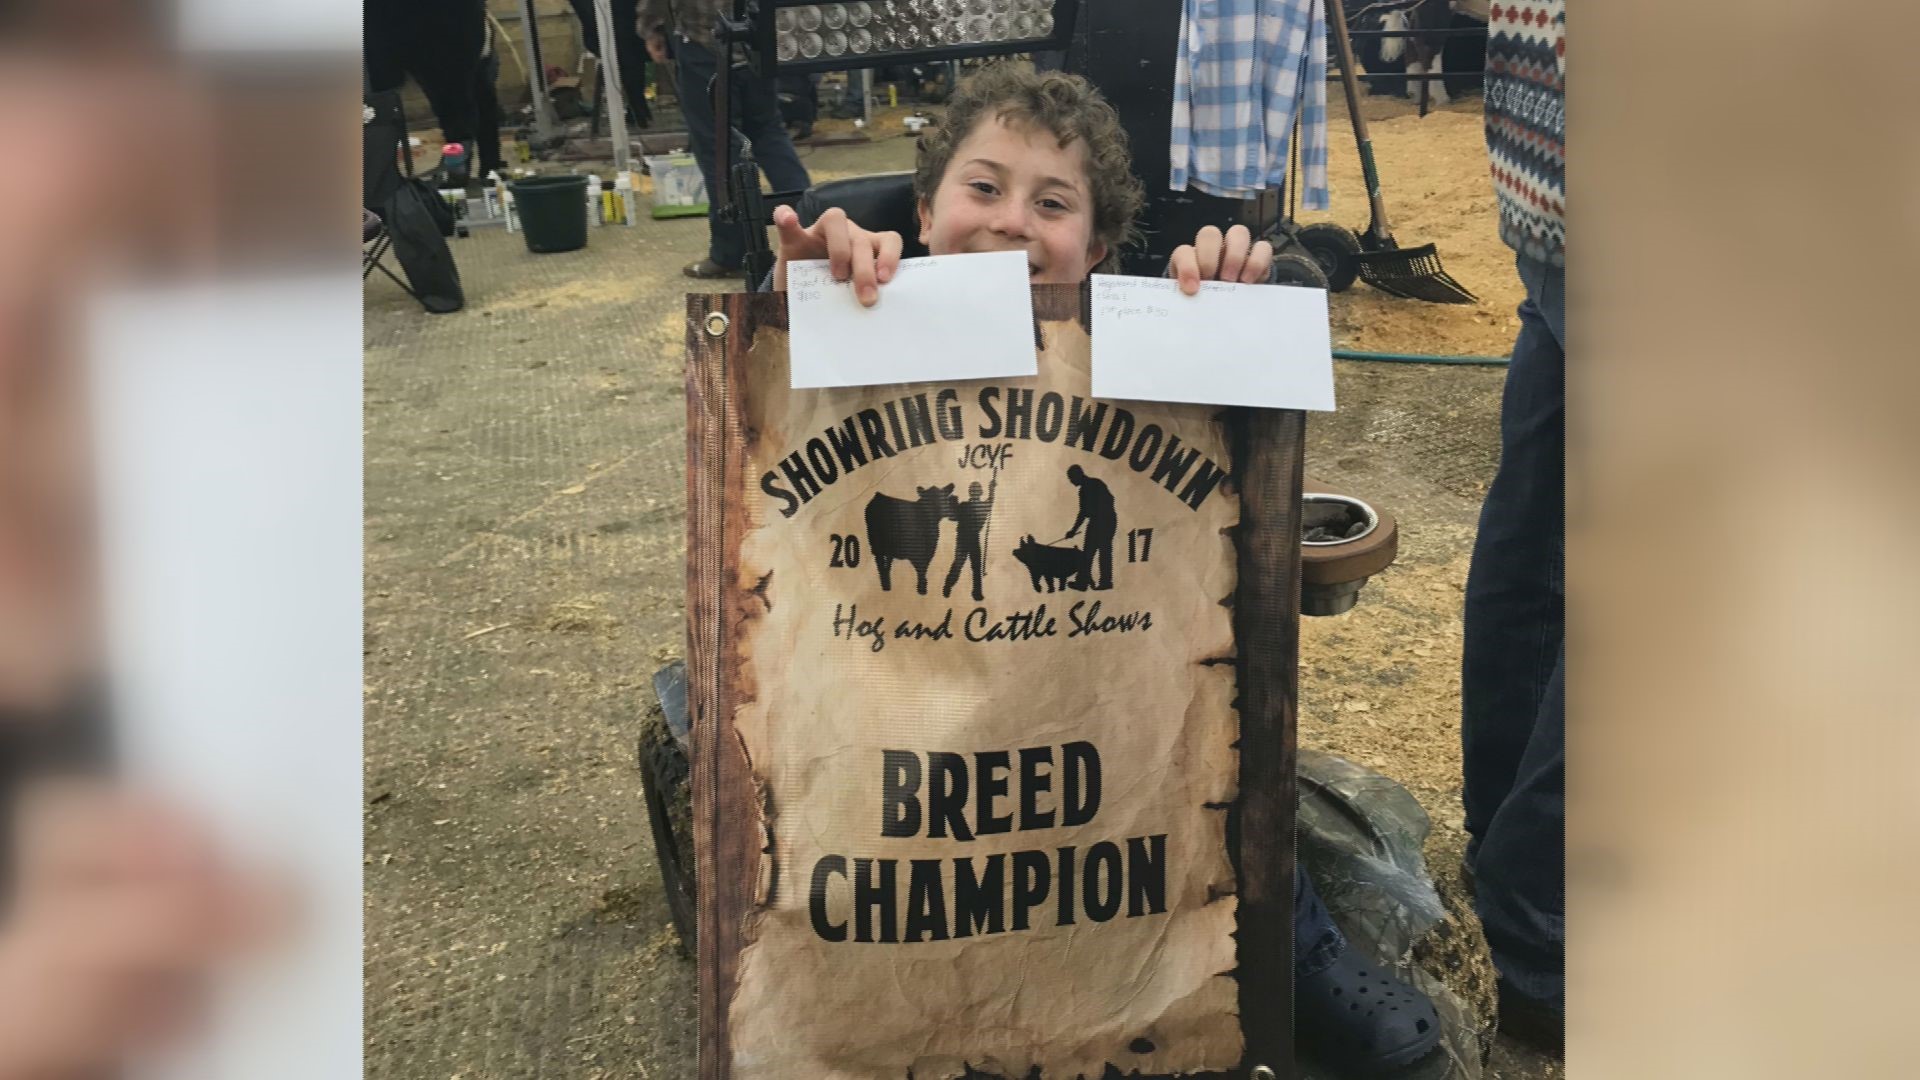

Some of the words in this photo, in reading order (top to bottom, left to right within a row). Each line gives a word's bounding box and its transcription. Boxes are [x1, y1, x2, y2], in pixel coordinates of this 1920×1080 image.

[760, 388, 965, 519] SHOWRING
[978, 386, 1227, 512] SHOWDOWN
[958, 442, 1014, 471] JCYF
[829, 533, 862, 569] 20
[1126, 527, 1155, 564] 17
[833, 602, 886, 653] Hog
[894, 607, 953, 642] and
[964, 602, 1057, 644] Cattle
[1066, 600, 1154, 639] Shows
[880, 740, 1103, 842] BREED
[808, 833, 1169, 945] CHAMPION
